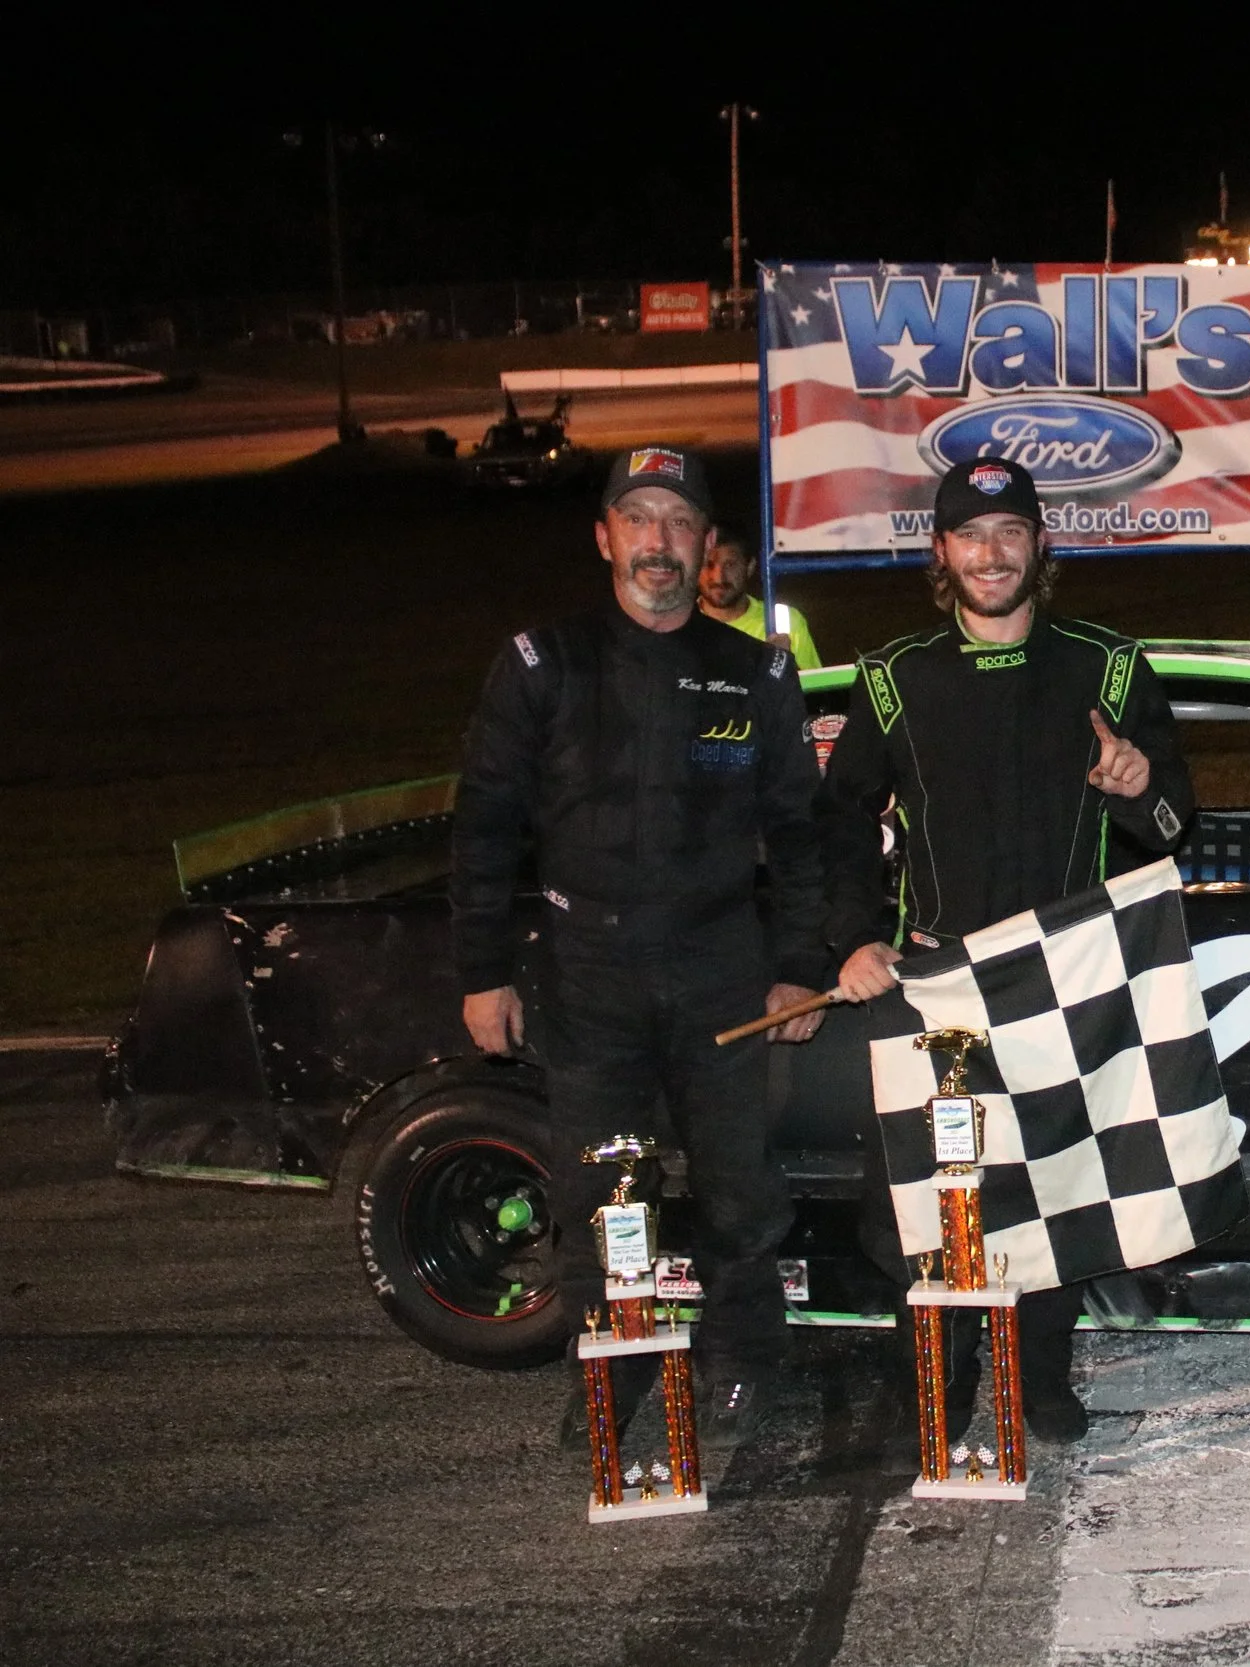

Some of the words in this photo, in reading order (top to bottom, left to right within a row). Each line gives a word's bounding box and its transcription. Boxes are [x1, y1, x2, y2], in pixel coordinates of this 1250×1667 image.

[977, 412, 1112, 472] Ford
[976, 651, 1027, 670] sparco
[870, 668, 894, 714] sparco
[1108, 654, 1128, 703] sparco
[951, 1146, 973, 1155] Place
[610, 1256, 623, 1265] 3rd
[625, 1255, 647, 1264] Place
